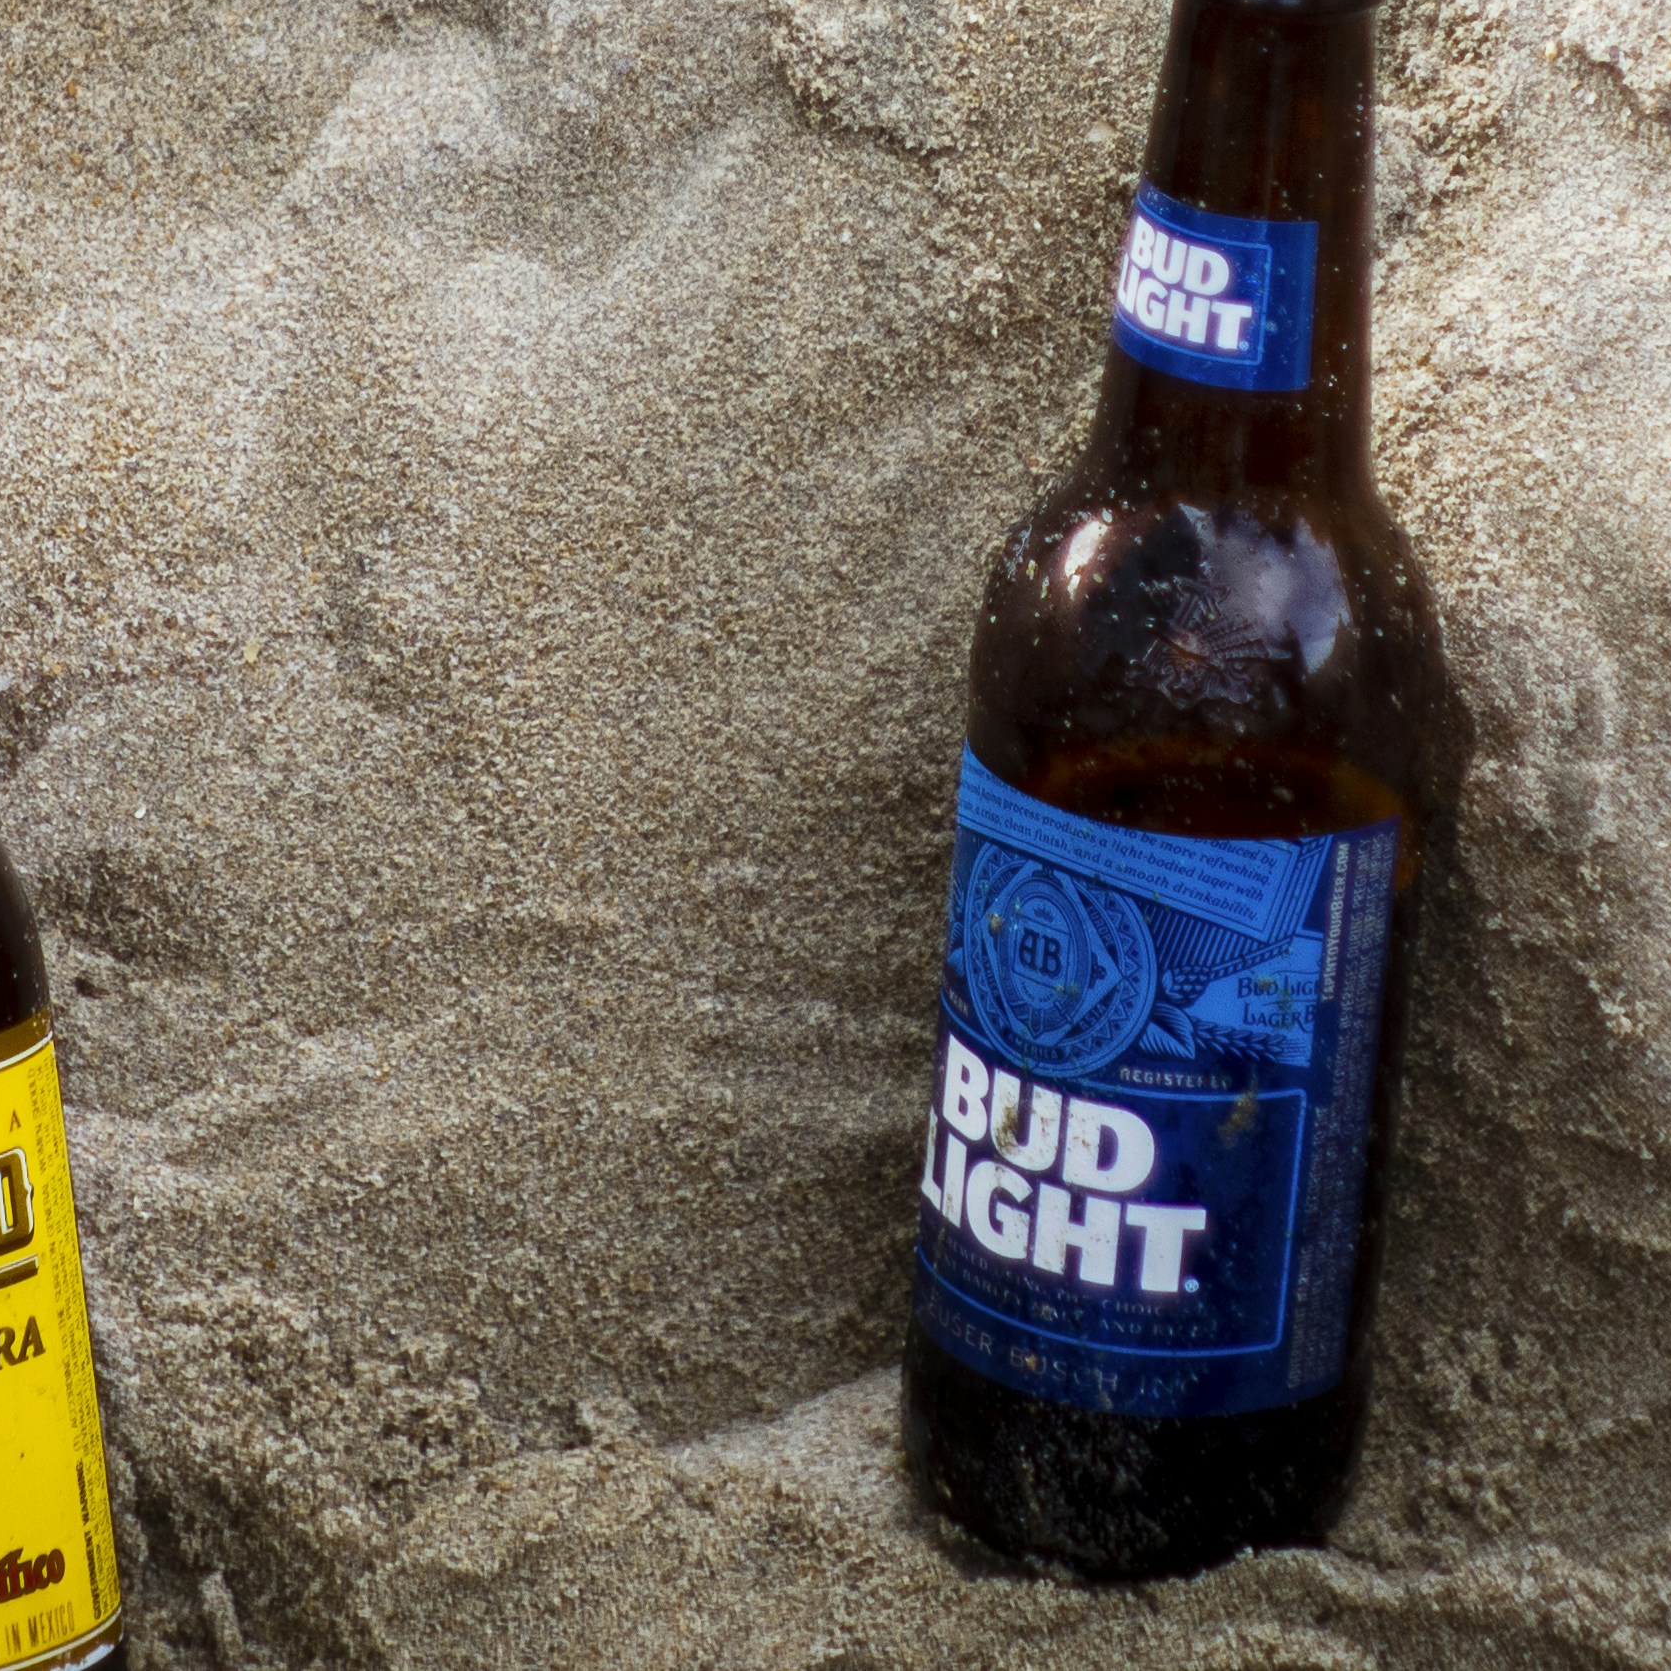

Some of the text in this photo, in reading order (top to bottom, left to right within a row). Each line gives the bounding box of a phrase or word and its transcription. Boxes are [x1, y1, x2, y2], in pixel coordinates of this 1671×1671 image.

[1131, 216, 1230, 296] BUD
[1117, 253, 1253, 350] LIGHT
[1003, 798, 1041, 821] process
[1042, 815, 1096, 844] produces
[1098, 836, 1108, 848] a
[1113, 838, 1197, 878] light-bodied
[1197, 868, 1233, 891] lager
[1234, 883, 1264, 903] with
[1005, 816, 1032, 837] clean
[1073, 847, 1101, 865] and
[1103, 858, 1114, 869] a
[1115, 864, 1171, 890] smooth
[1159, 839, 1197, 859] more
[1260, 851, 1278, 868] by
[941, 1032, 1156, 1195] BUD
[920, 1106, 1207, 1294] LIGHT
[5, 1622, 22, 1656] IN
[28, 1600, 76, 1648] MEXICO
